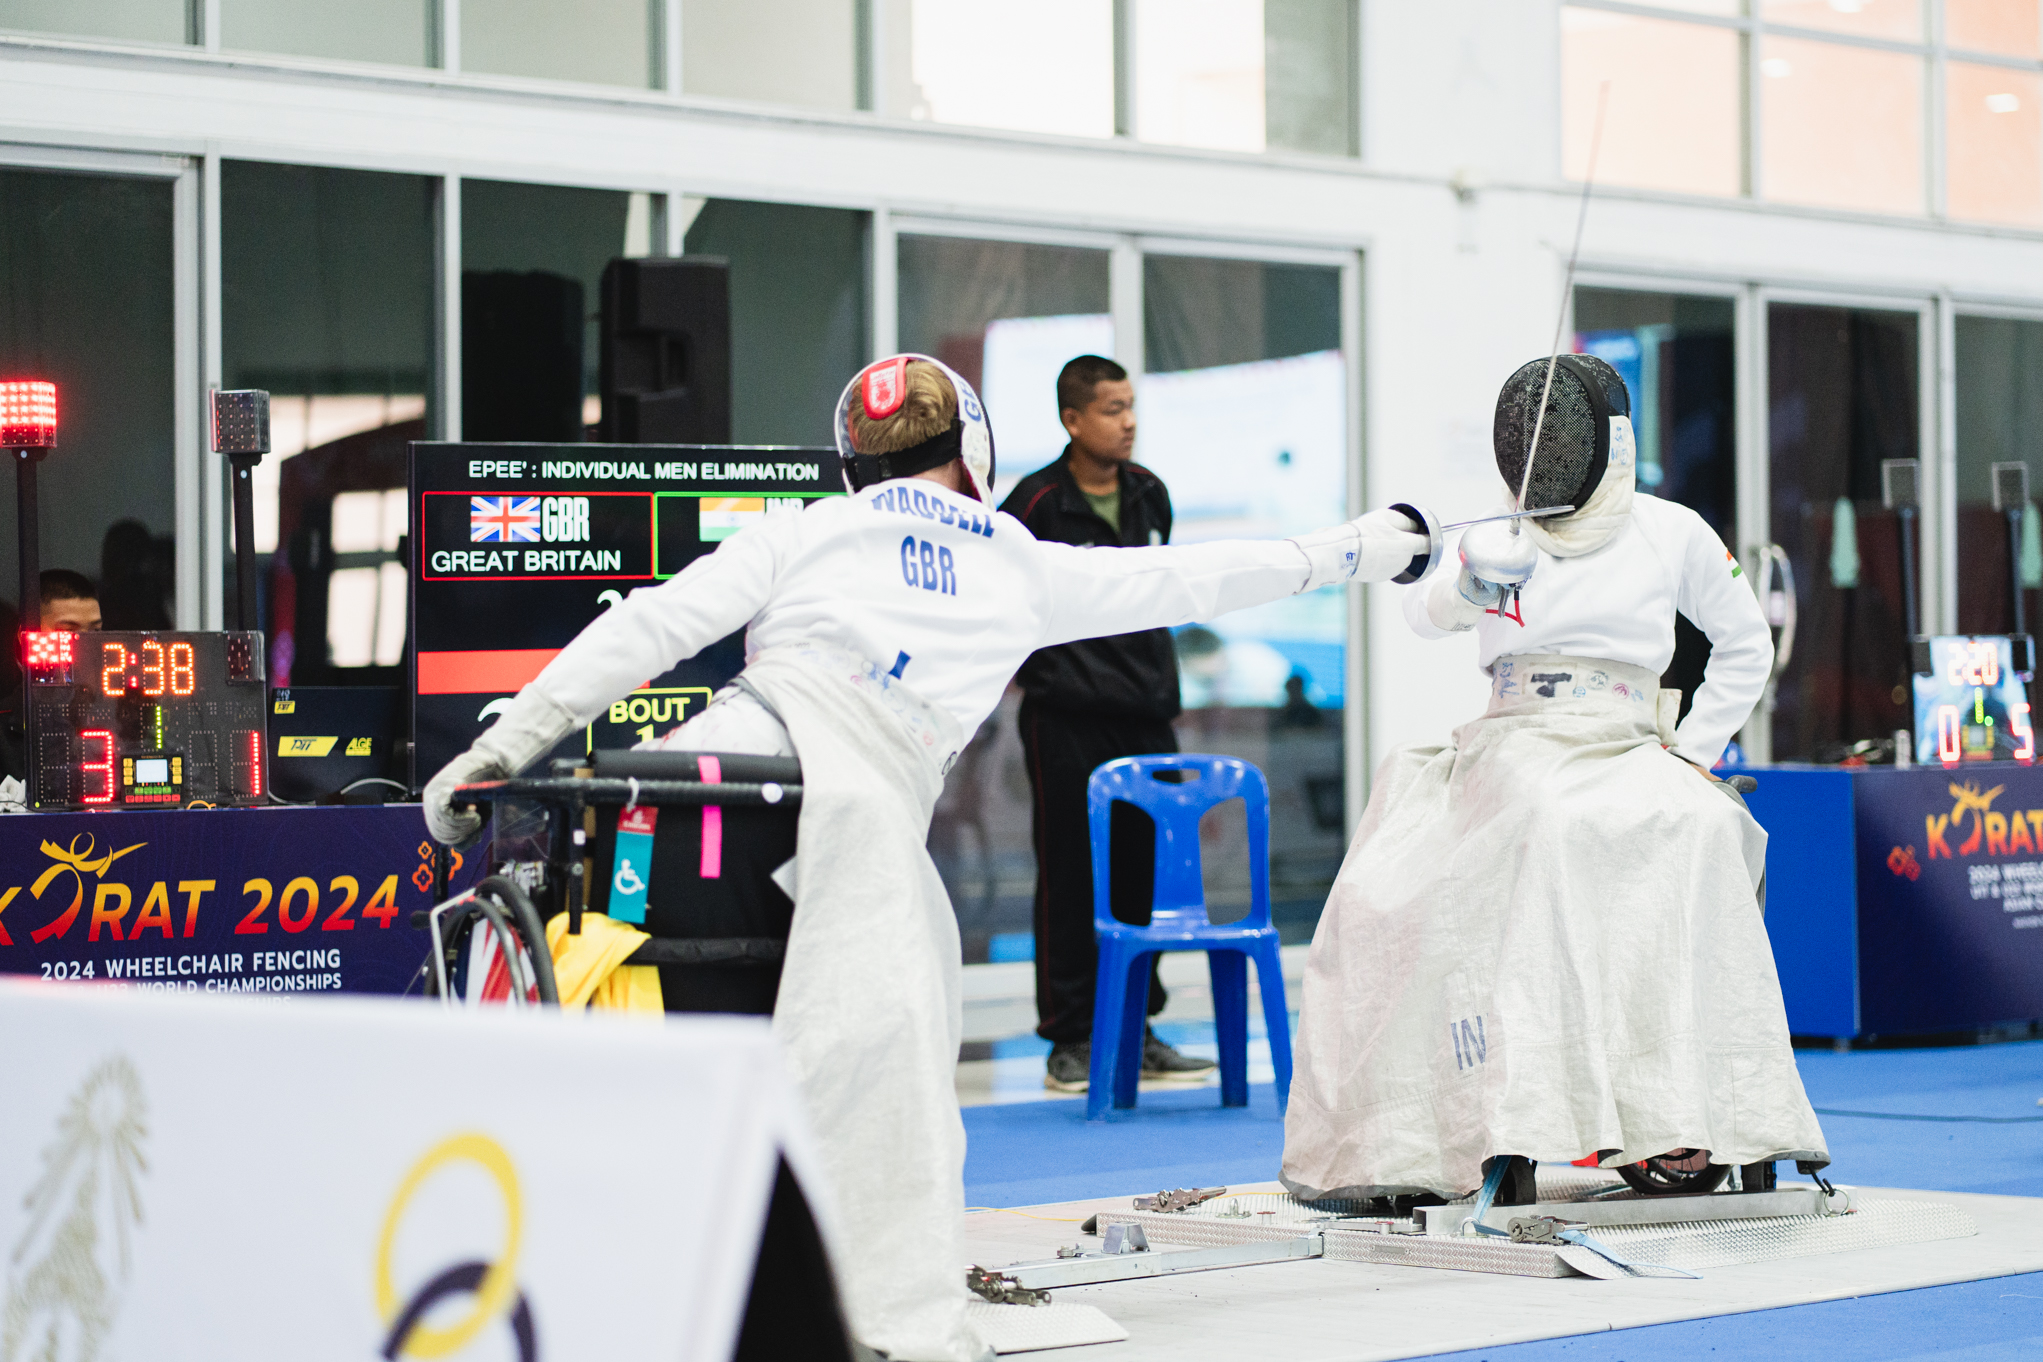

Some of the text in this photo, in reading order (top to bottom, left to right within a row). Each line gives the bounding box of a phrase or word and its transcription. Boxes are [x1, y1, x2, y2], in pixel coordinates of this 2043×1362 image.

[469, 460, 528, 478] EPEE'
[541, 461, 651, 480] INDIVIDUAL
[654, 462, 697, 480] MEN
[701, 463, 819, 481] ELIMINATION
[542, 496, 590, 542] GBR
[431, 550, 621, 572] GREAT BRITAIN
[900, 535, 957, 596] GBR
[102, 642, 195, 696] 2:38
[609, 697, 690, 723] BOUT
[1938, 705, 1961, 762] 0
[2011, 702, 2034, 760] 5
[81, 730, 114, 803] 3
[251, 730, 262, 796] 1
[234, 874, 399, 935] 2024
[41, 949, 341, 981] 2024 WHEELCHAIR FENCING
[205, 972, 342, 995] CHAMPIONSHIPS
[1450, 1014, 1488, 1071] IN
